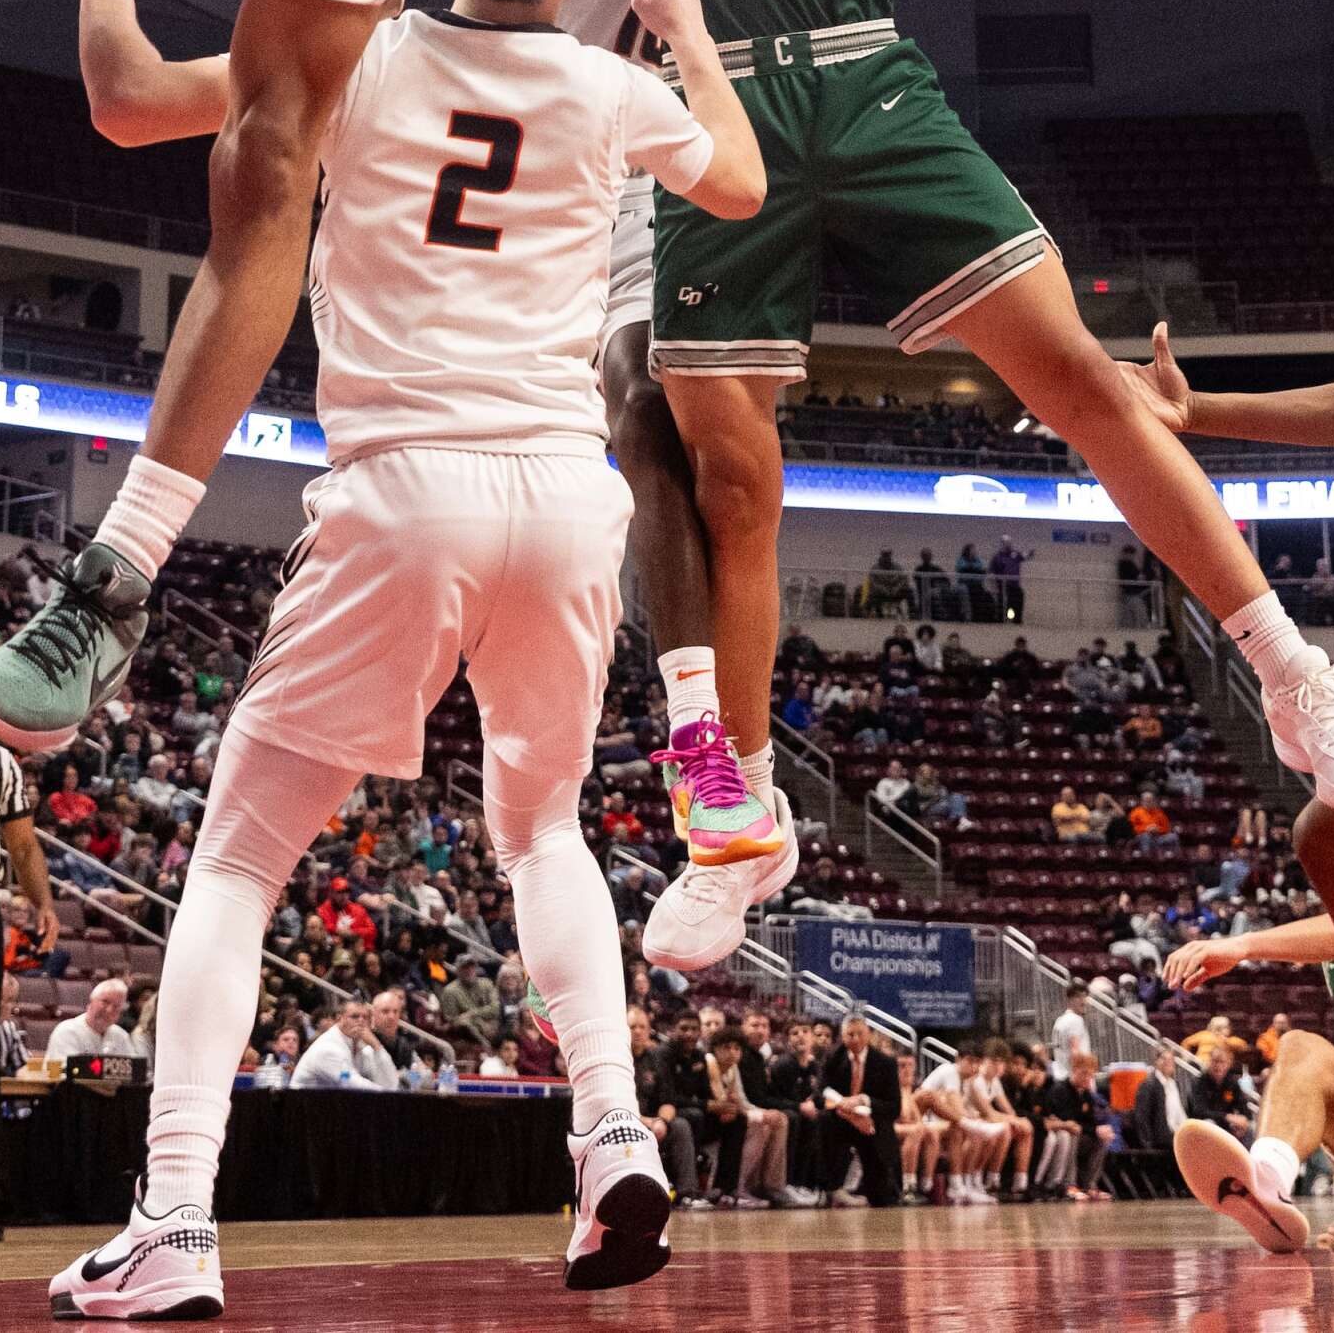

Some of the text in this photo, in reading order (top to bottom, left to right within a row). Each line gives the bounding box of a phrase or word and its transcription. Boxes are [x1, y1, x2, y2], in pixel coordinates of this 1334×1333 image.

[773, 36, 794, 66] C
[423, 109, 525, 253] 2
[677, 287, 703, 306] CD
[872, 929, 922, 952] District
[830, 951, 943, 978] Championships
